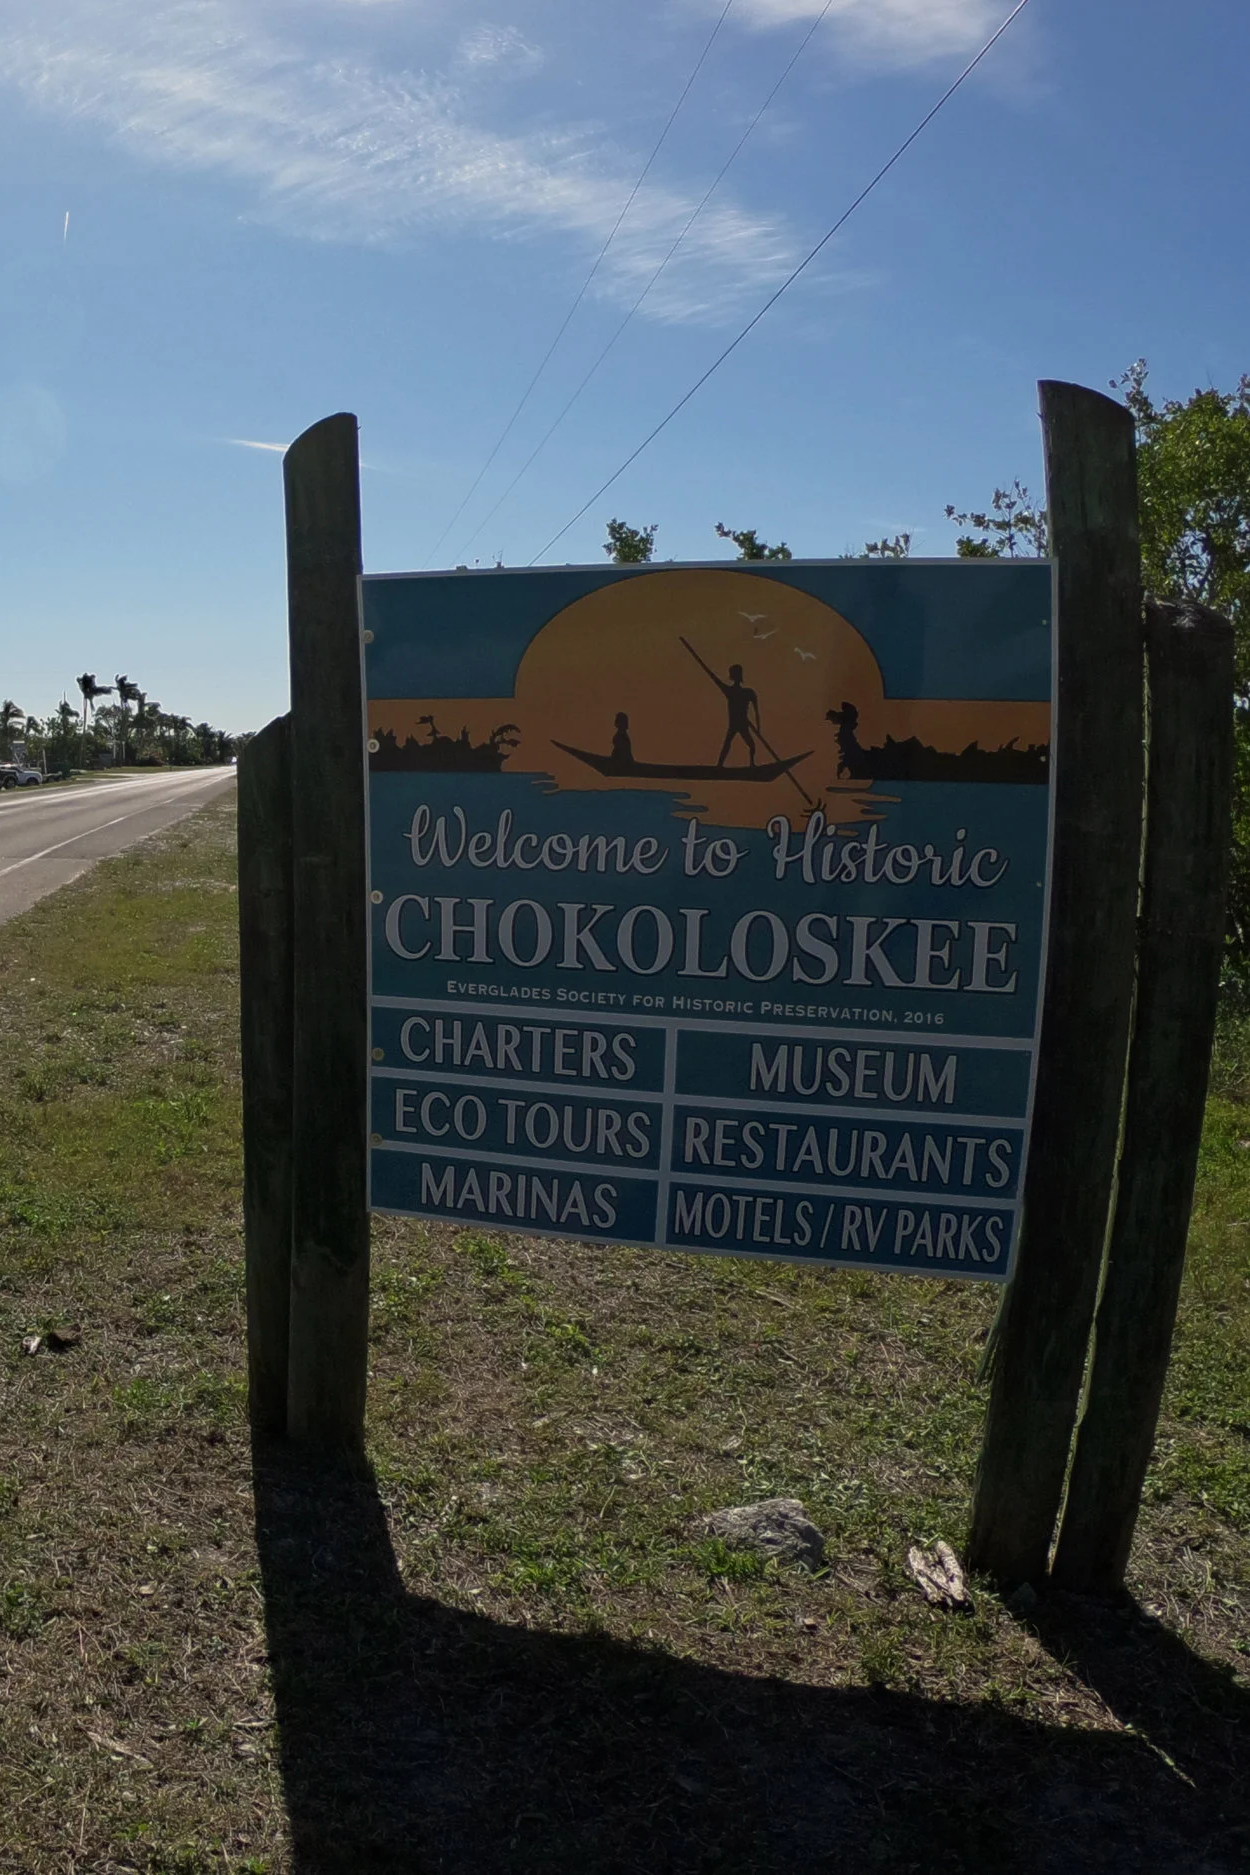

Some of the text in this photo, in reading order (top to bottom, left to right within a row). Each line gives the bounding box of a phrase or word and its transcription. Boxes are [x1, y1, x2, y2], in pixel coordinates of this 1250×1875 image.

[403, 804, 1008, 888] Welcome to Historic
[385, 894, 1018, 993] CHOKOLOSKEE
[633, 994, 667, 1008] FOR
[903, 1011, 944, 1025] 2016
[400, 1016, 637, 1081] CHARTERS
[751, 1042, 957, 1104] MUSEUM
[395, 1088, 651, 1158] ECO TOURS
[684, 1117, 1012, 1188] RESTAURANTS
[421, 1163, 616, 1229] MARINAS
[894, 1211, 1004, 1263] PARKS
